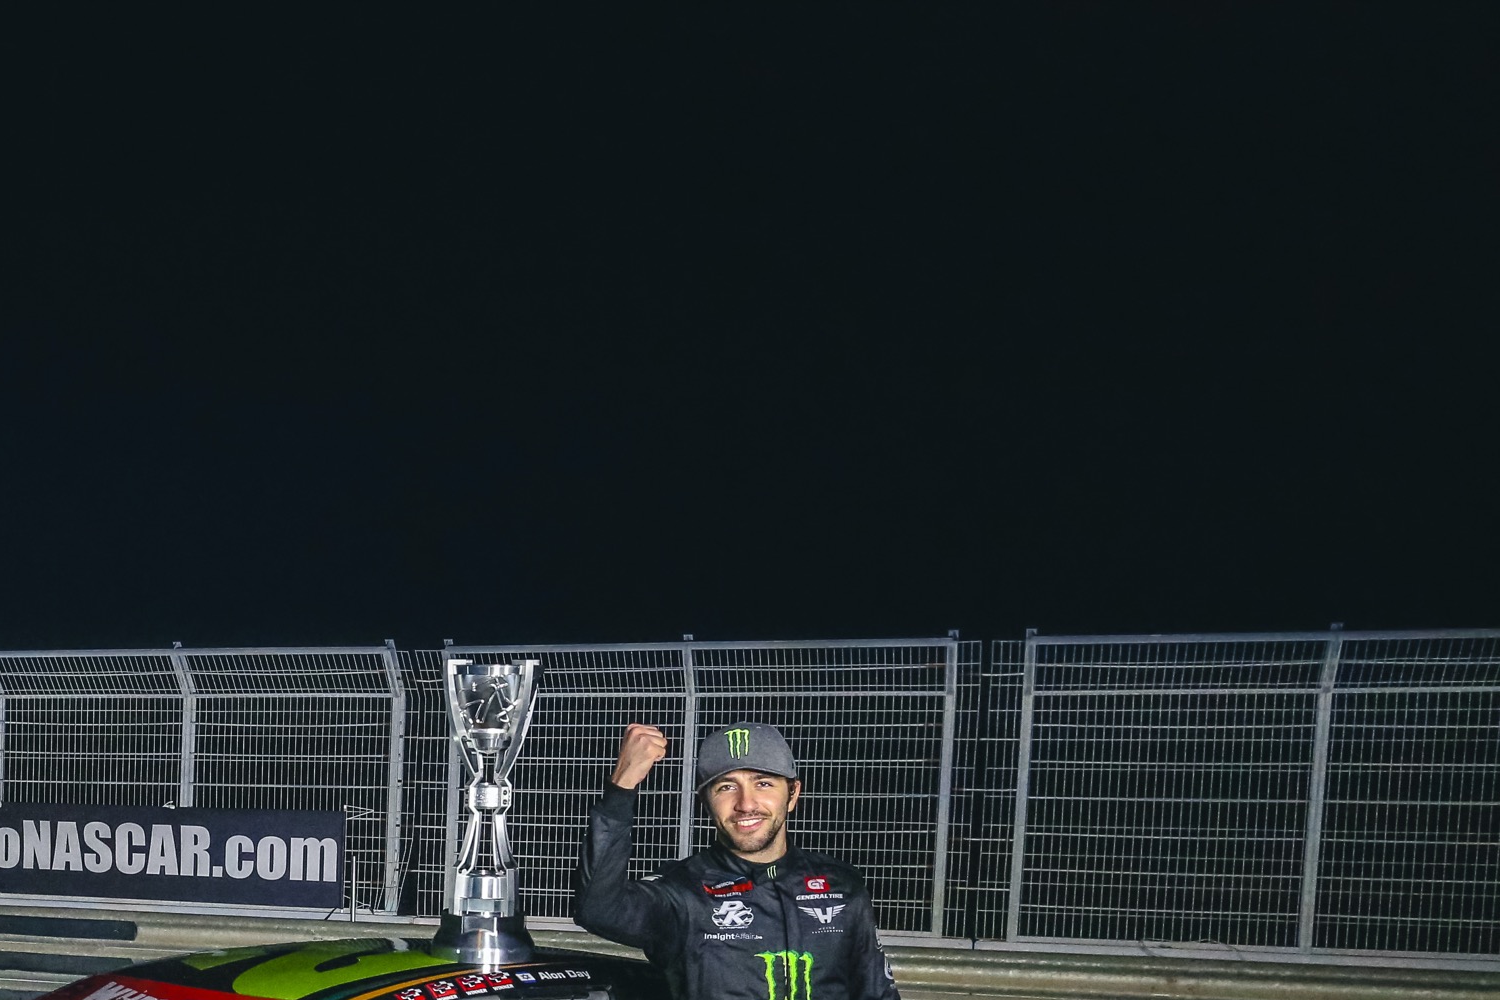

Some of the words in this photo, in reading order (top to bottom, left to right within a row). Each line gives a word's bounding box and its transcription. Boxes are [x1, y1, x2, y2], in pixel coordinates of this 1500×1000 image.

[796, 893, 828, 901] GENERAL
[538, 971, 565, 980] Alon
[567, 969, 591, 980] Day
[493, 983, 515, 991] WINNER
[466, 988, 488, 996] WINNER
